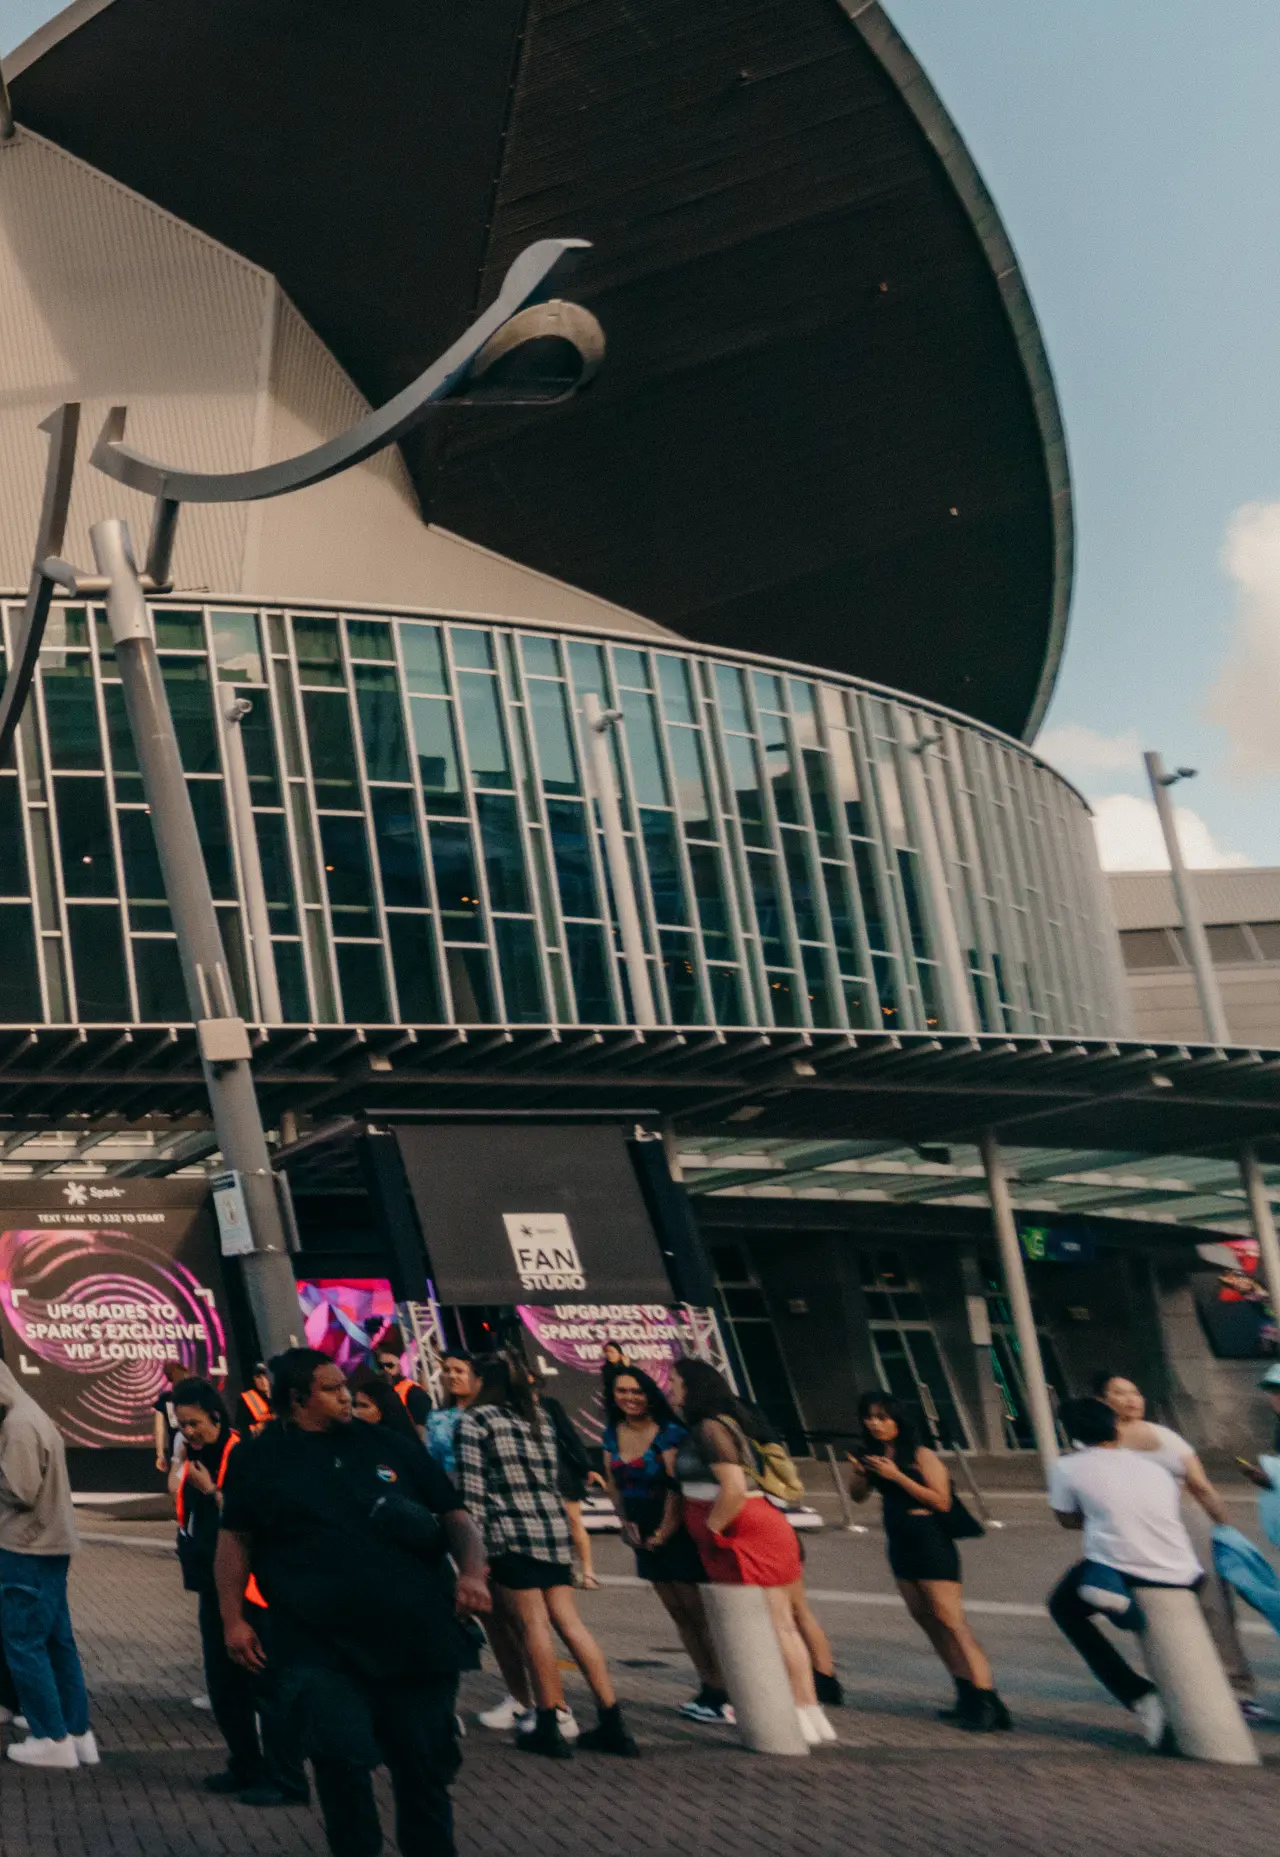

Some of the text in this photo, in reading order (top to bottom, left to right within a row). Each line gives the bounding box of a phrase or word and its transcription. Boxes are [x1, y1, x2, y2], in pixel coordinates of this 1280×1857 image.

[89, 1186, 120, 1199] Spark
[37, 1213, 60, 1223] TEXT
[517, 1248, 576, 1271] FAN
[521, 1274, 586, 1290] STUDIO
[47, 1303, 178, 1320] UPGRADES TO
[554, 1304, 667, 1320] UPGRADES TO
[24, 1323, 207, 1340] SPARK'S EXCLUSIVE
[540, 1324, 607, 1340] SPARK'S
[64, 1343, 179, 1360] VIP LOUNGE
